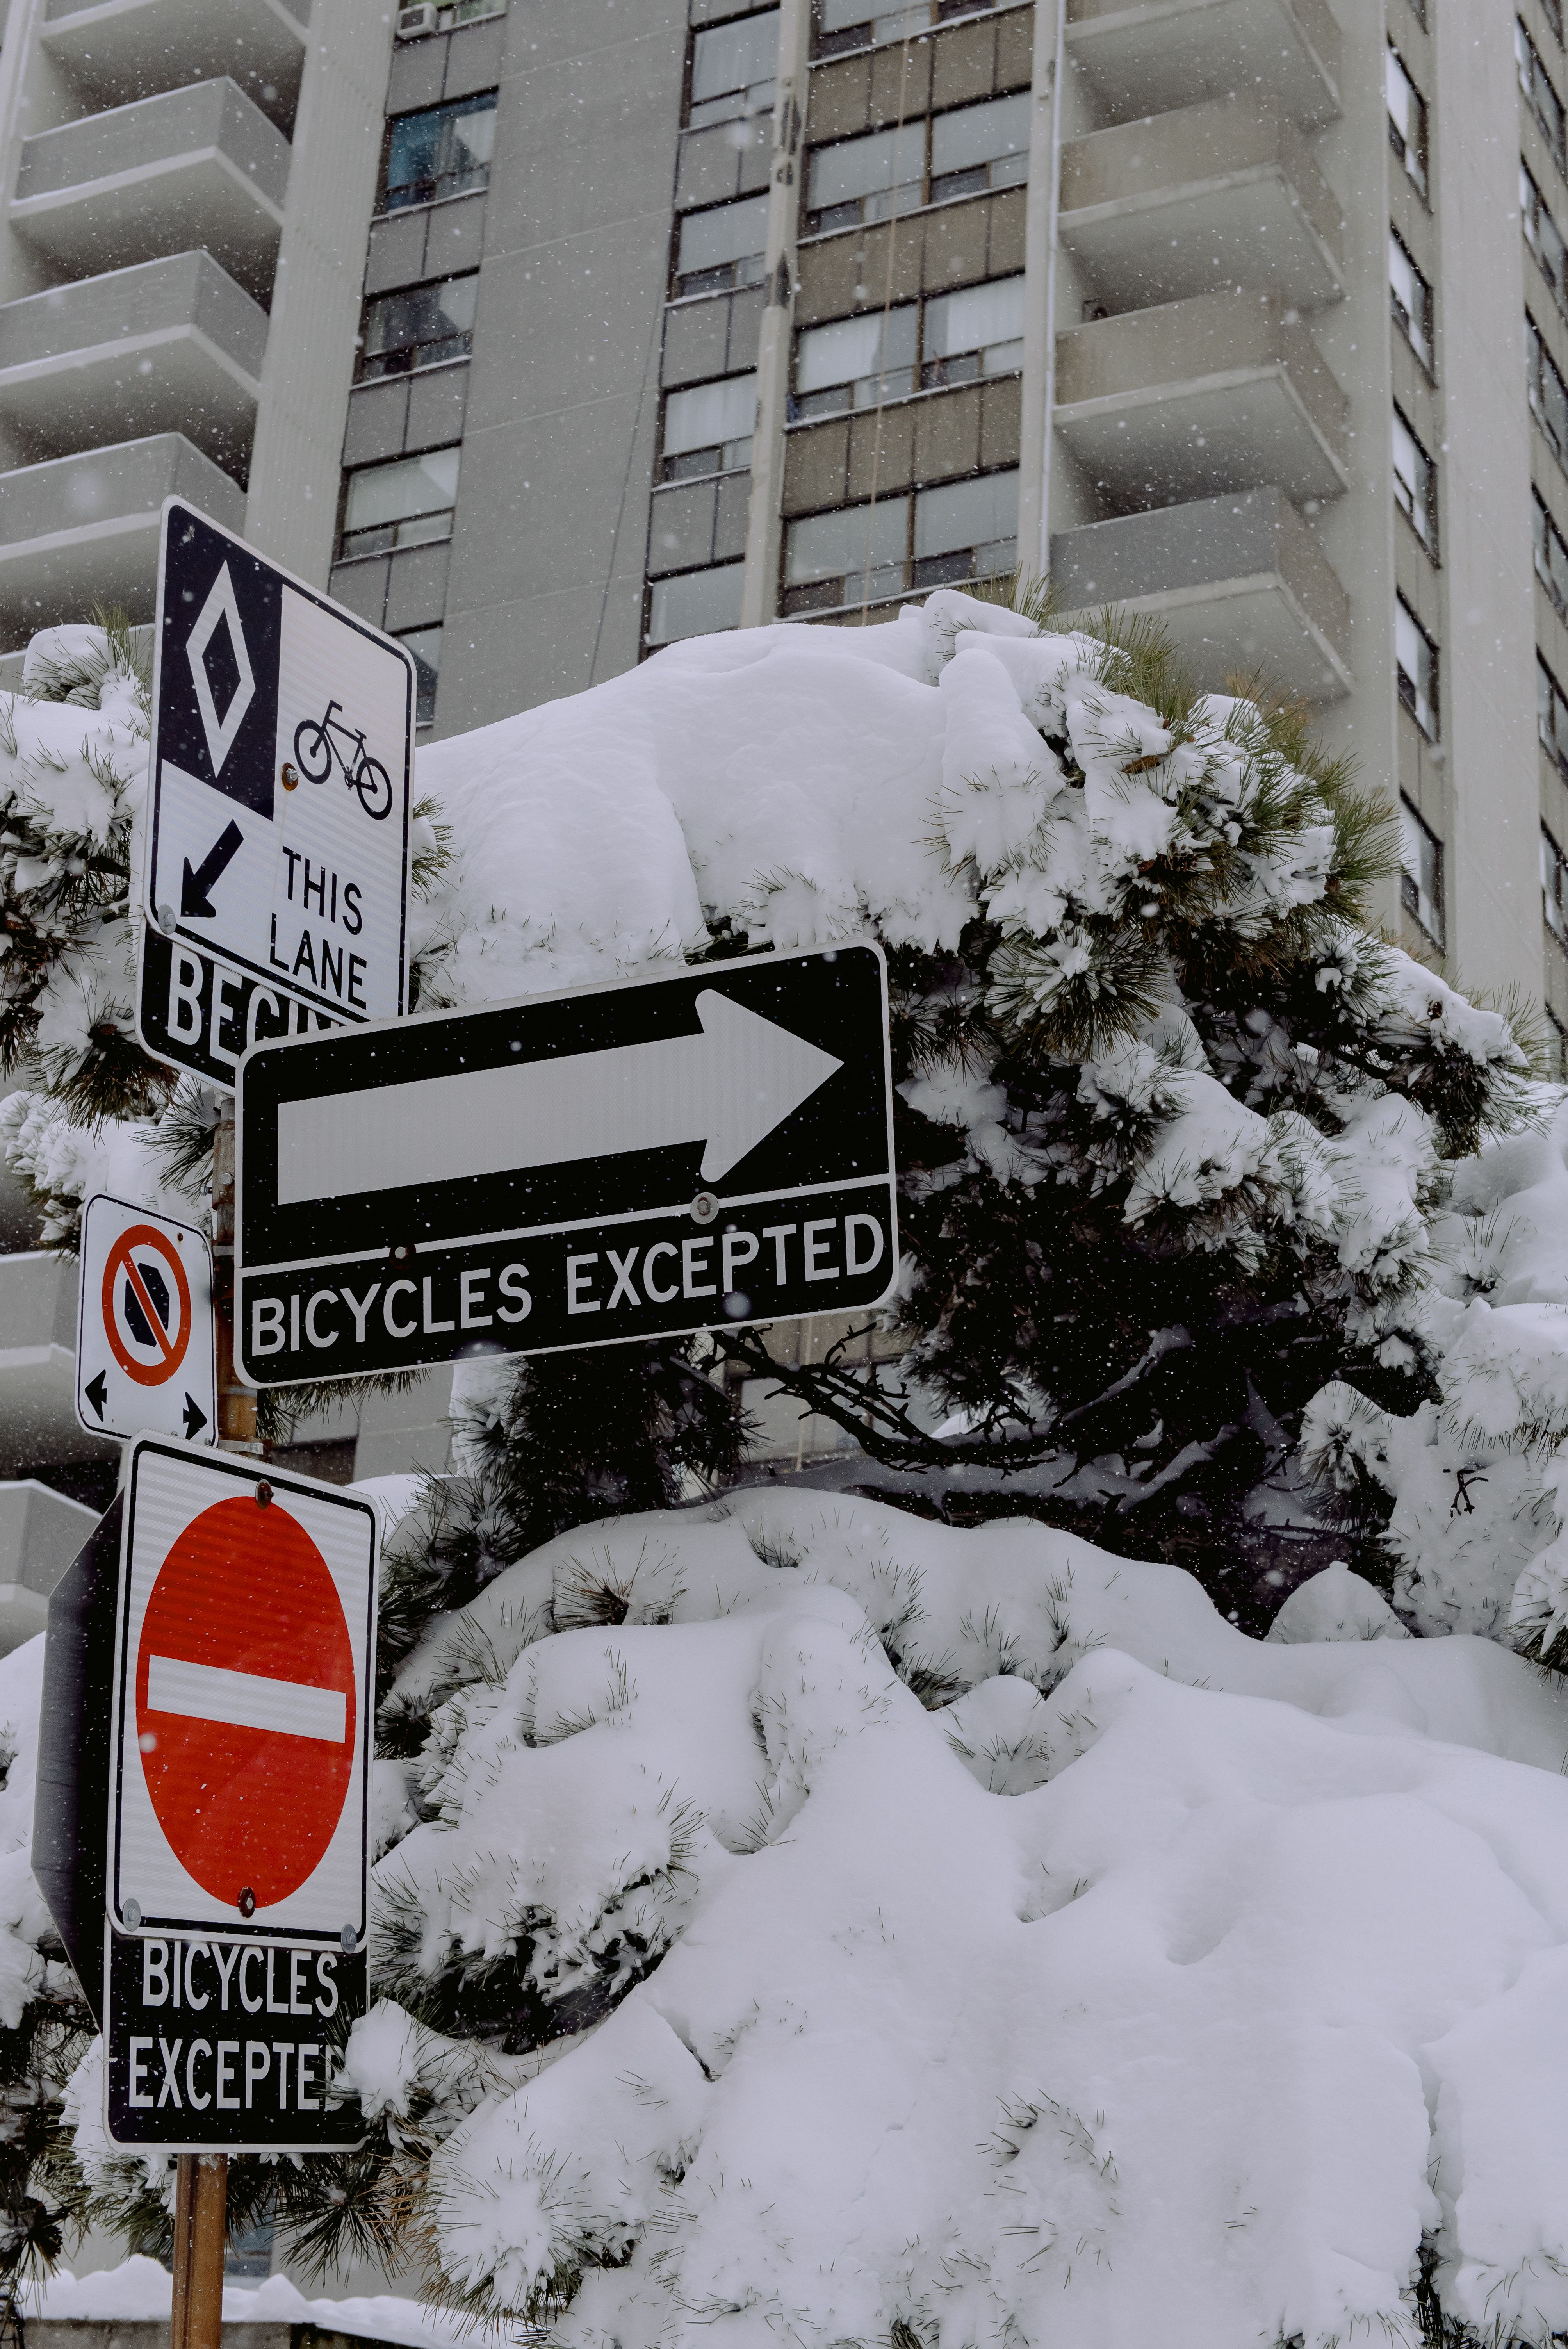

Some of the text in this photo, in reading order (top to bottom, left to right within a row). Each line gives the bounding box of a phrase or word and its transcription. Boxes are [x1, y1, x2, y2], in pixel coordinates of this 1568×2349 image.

[282, 845, 362, 935] THIS
[270, 913, 367, 1010] LANE
[252, 1214, 884, 1356] BICYCLES EXCEPTED
[143, 1938, 339, 2017] BICYCLES
